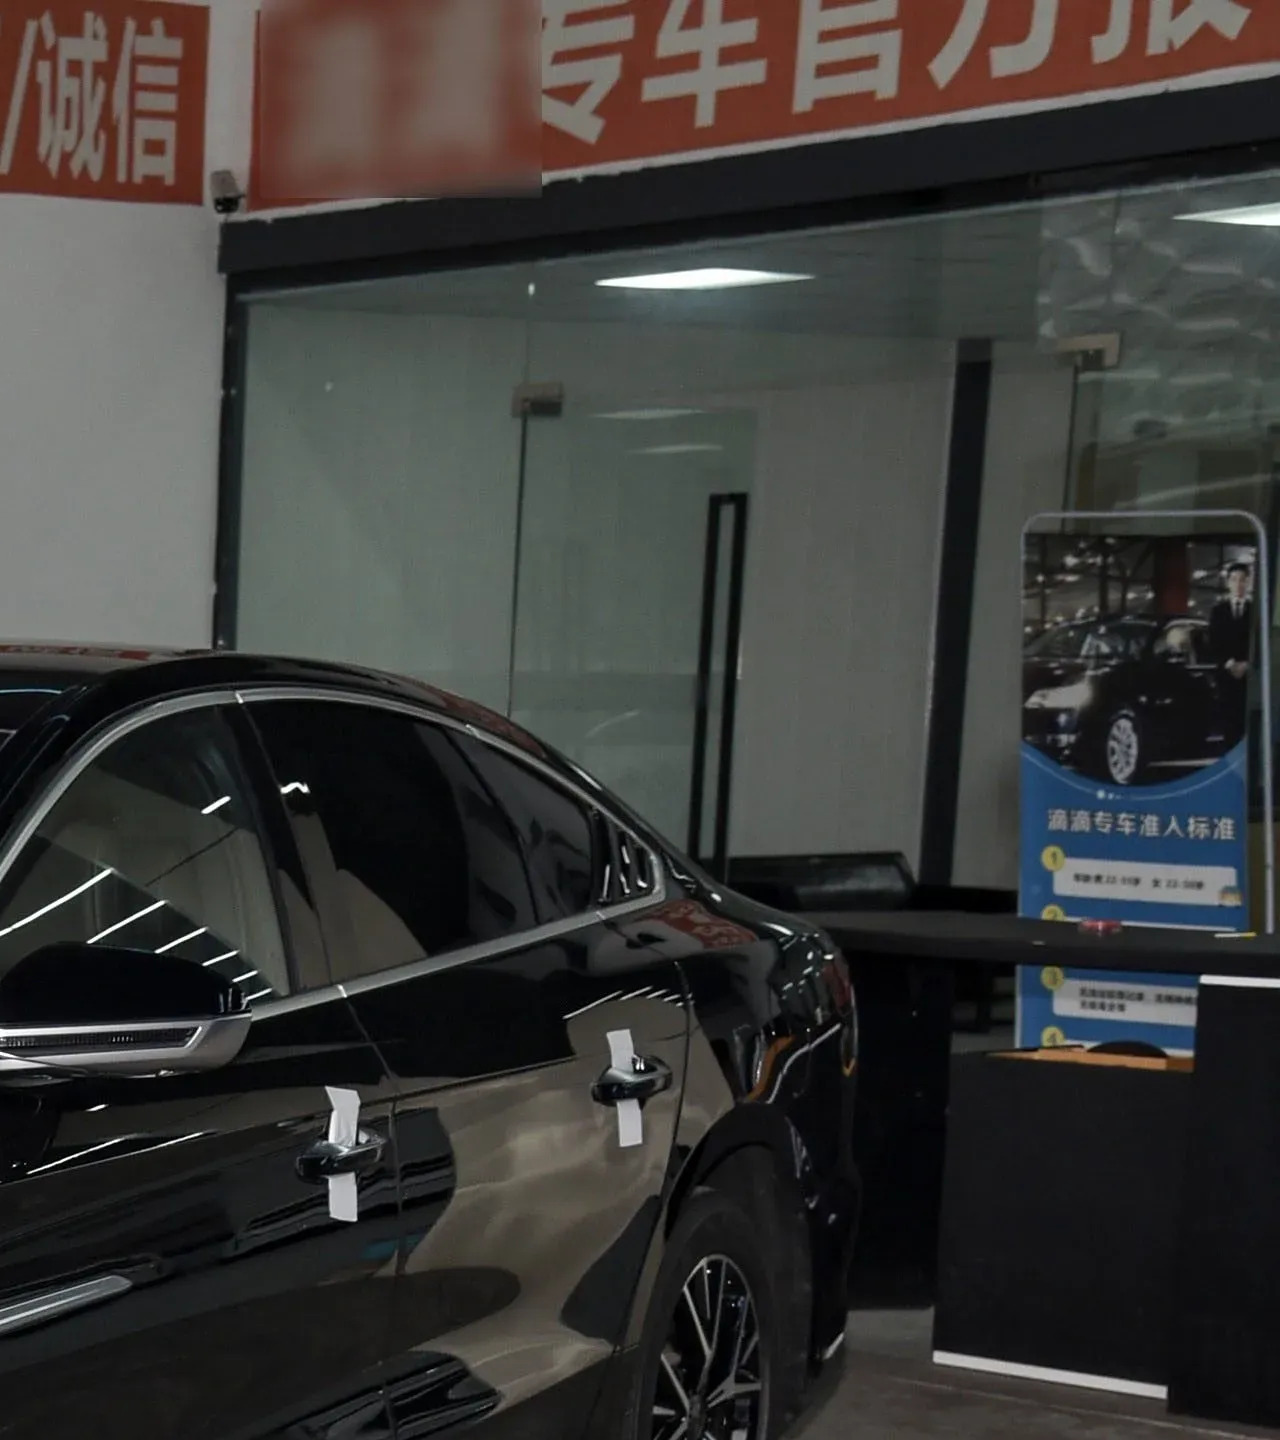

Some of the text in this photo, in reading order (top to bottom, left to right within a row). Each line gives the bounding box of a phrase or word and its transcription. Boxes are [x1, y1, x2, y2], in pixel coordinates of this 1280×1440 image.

[1047, 808, 1236, 841] 滴滴专车准入标准
